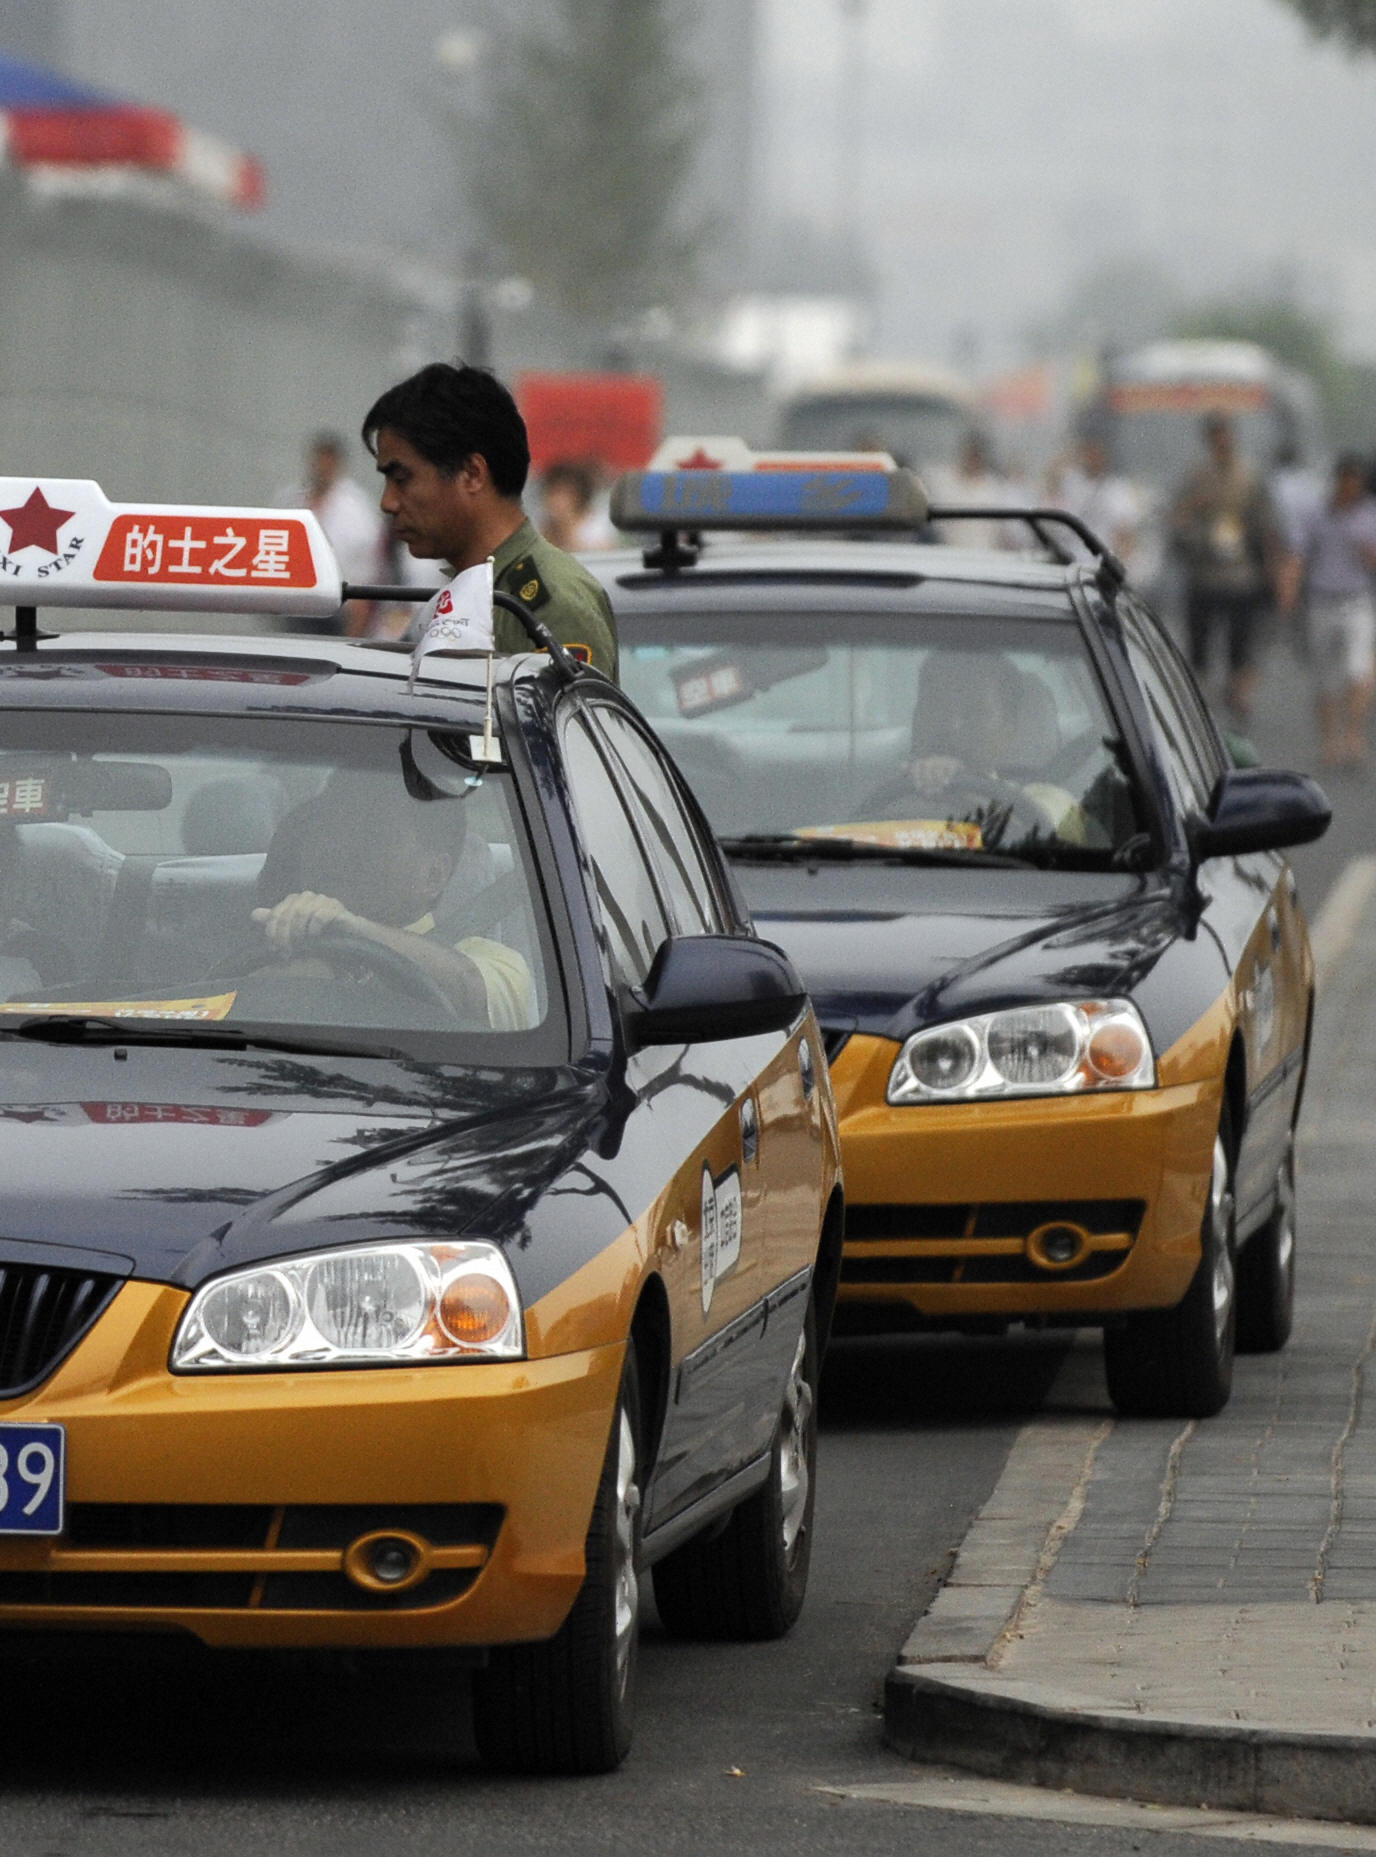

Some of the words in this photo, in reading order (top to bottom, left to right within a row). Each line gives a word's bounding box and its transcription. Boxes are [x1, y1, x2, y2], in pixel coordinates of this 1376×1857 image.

[37, 536, 85, 579] STAR
[124, 524, 291, 579] 的士之星
